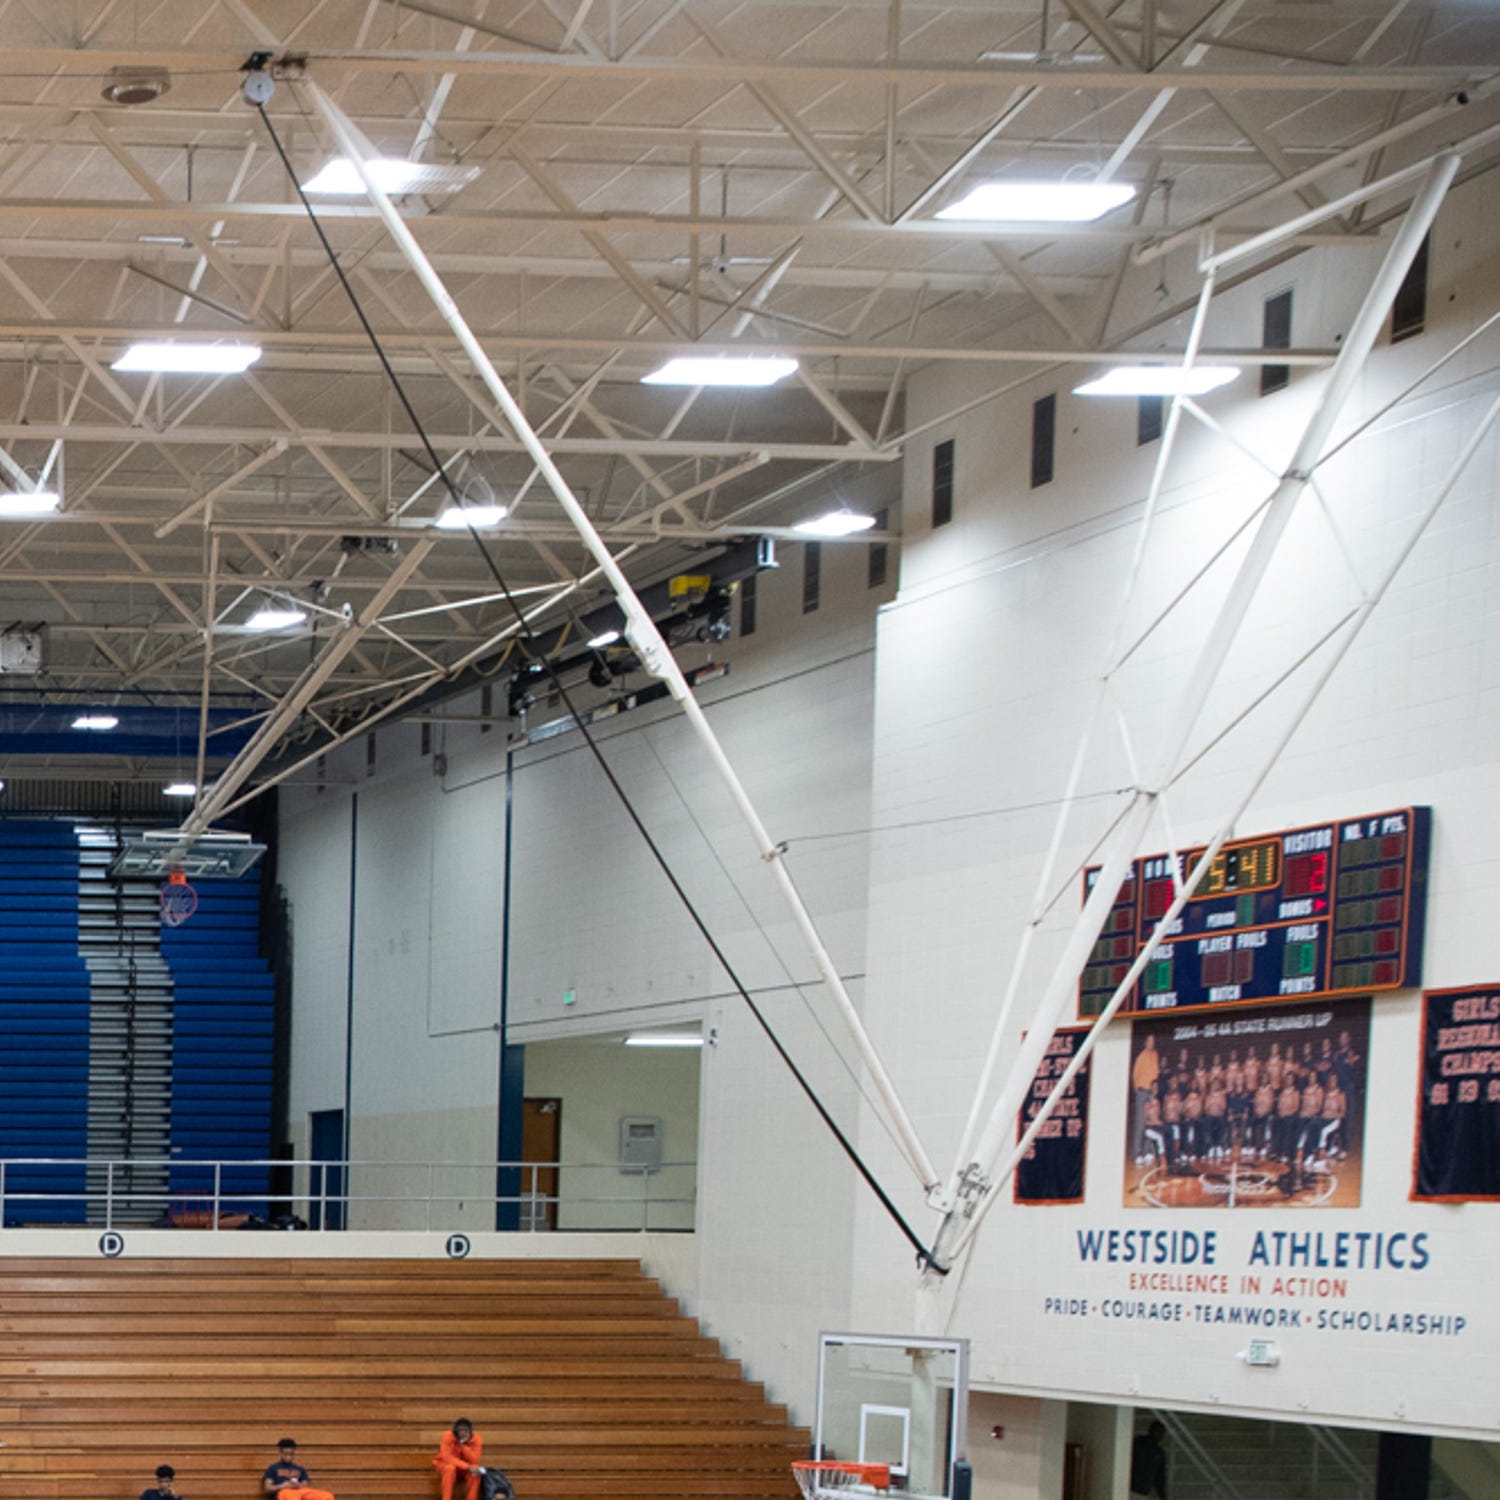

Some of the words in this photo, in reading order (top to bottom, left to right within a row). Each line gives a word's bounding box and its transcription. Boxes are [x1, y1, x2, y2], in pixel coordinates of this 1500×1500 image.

[1368, 819, 1378, 837] F
[1283, 831, 1332, 854] VISITOR
[1309, 852, 1326, 892] 2
[1279, 899, 1313, 919] BONUS
[1198, 936, 1233, 955] PLAYER
[1236, 931, 1267, 950] FOULS
[1286, 924, 1318, 943] FOULS
[1233, 1018, 1266, 1035] STATE
[1315, 1011, 1333, 1027] UP
[103, 1234, 120, 1254] D
[451, 1236, 468, 1256] D
[1077, 1230, 1217, 1265] WESTSIDE
[1249, 1231, 1430, 1270] ATHLETICS
[1129, 1273, 1228, 1293] EXCELLENCE
[1240, 1276, 1261, 1294] IN
[1271, 1277, 1347, 1298] ACTION
[1044, 1298, 1088, 1316] PRIDE
[1101, 1299, 1182, 1322] COURAGE
[1194, 1304, 1302, 1328] TEAMWORK
[1316, 1309, 1467, 1336] SCHOLARSHIP
